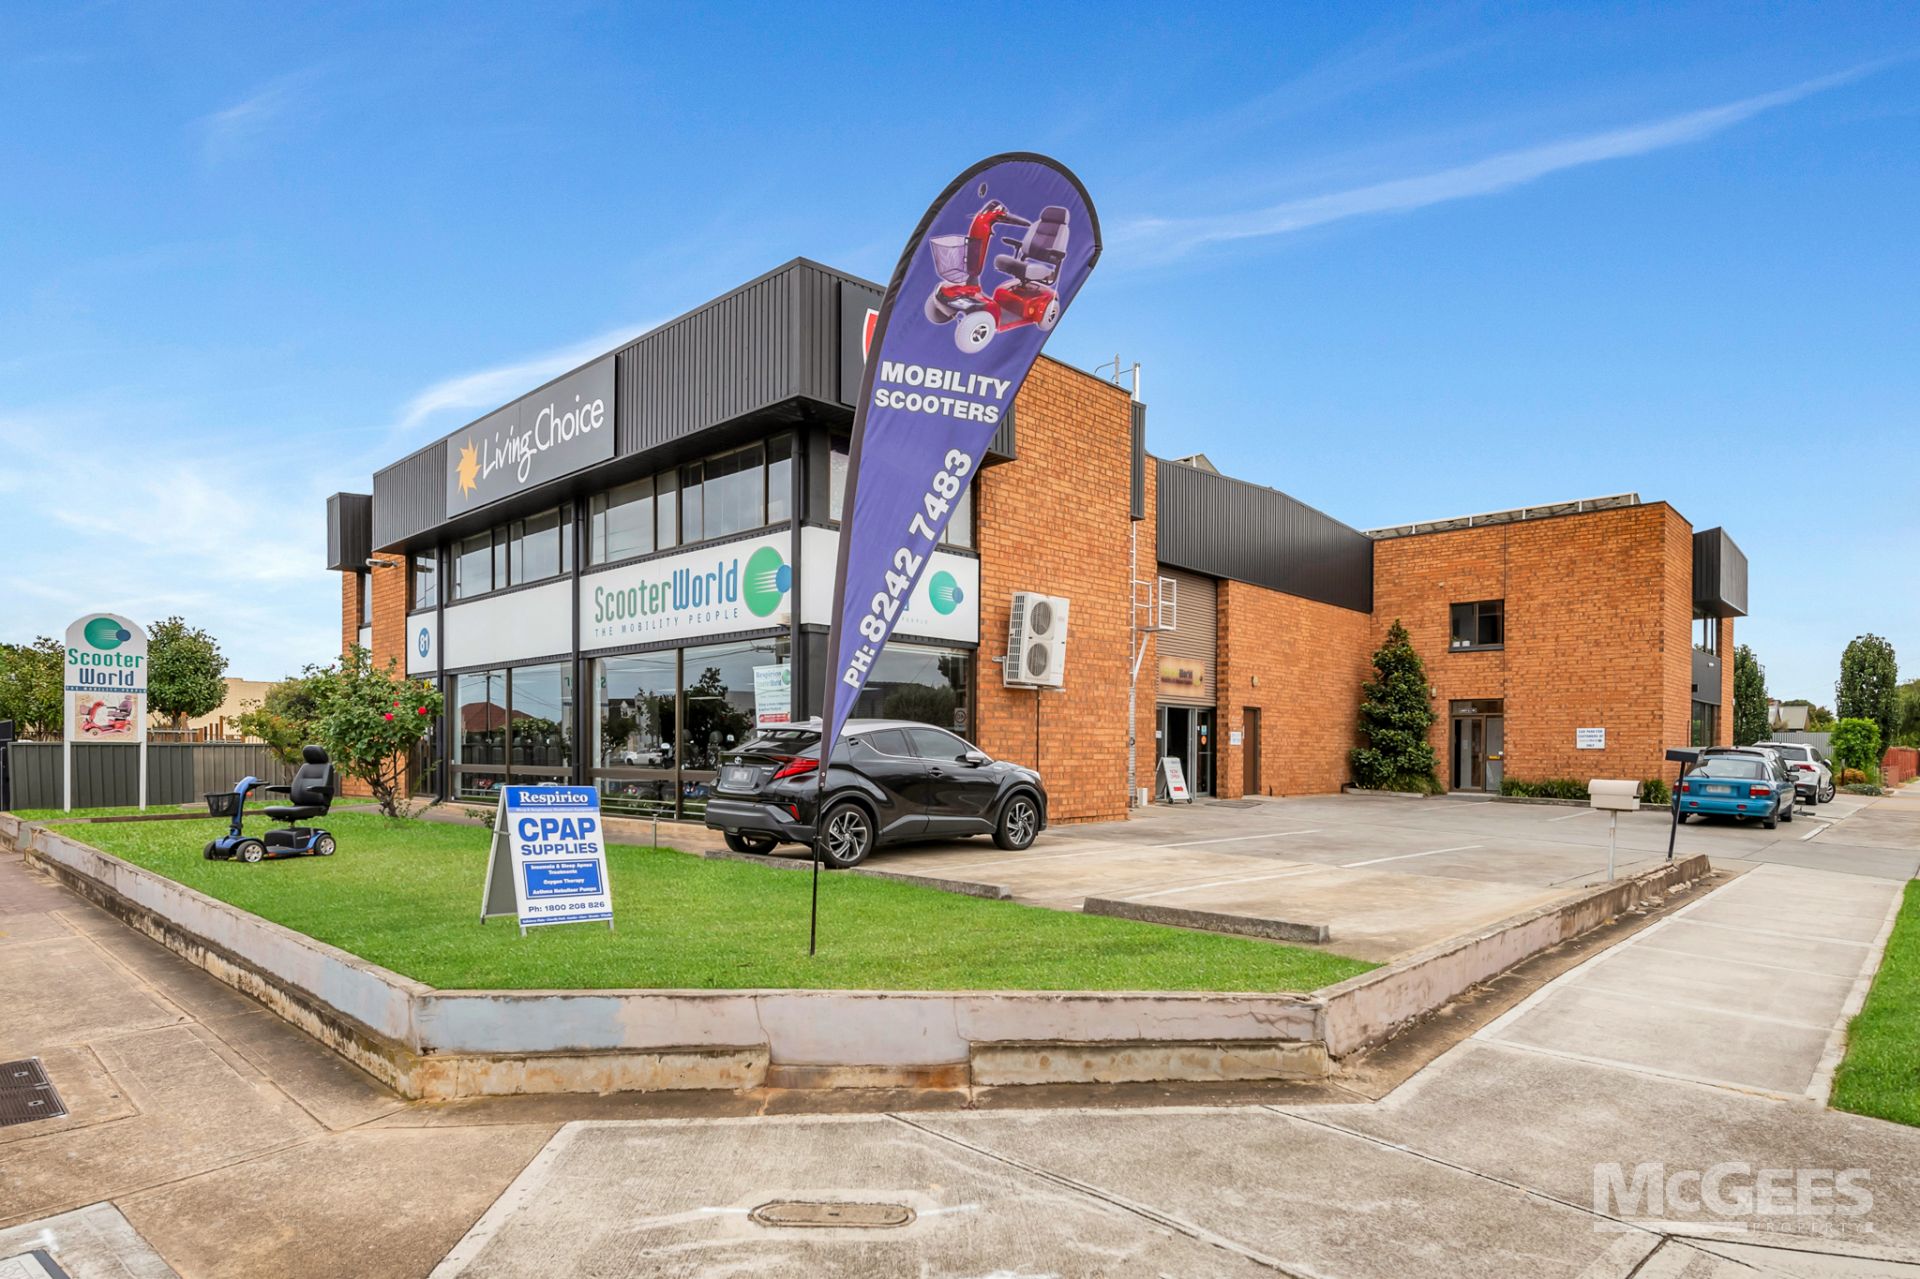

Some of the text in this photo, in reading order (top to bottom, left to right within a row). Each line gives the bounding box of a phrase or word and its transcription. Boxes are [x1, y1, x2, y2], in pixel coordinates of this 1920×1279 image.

[880, 361, 1012, 399] MOBILITY
[874, 388, 1000, 424] SCOOTERS
[482, 394, 605, 484] Living Choice
[842, 448, 972, 689] PH: 8242 7483
[594, 557, 739, 624] ScooterWorld
[594, 607, 739, 638] THE MOBILITY PEOPLE
[419, 633, 429, 652] 81
[68, 648, 144, 668] Scooter
[79, 668, 135, 686] World
[518, 790, 589, 806] Respirico
[518, 817, 596, 842] CPAP
[521, 842, 598, 856] SUPPLIES
[528, 905, 543, 913] Ph:
[545, 904, 567, 912] 1800
[568, 902, 586, 910] 208
